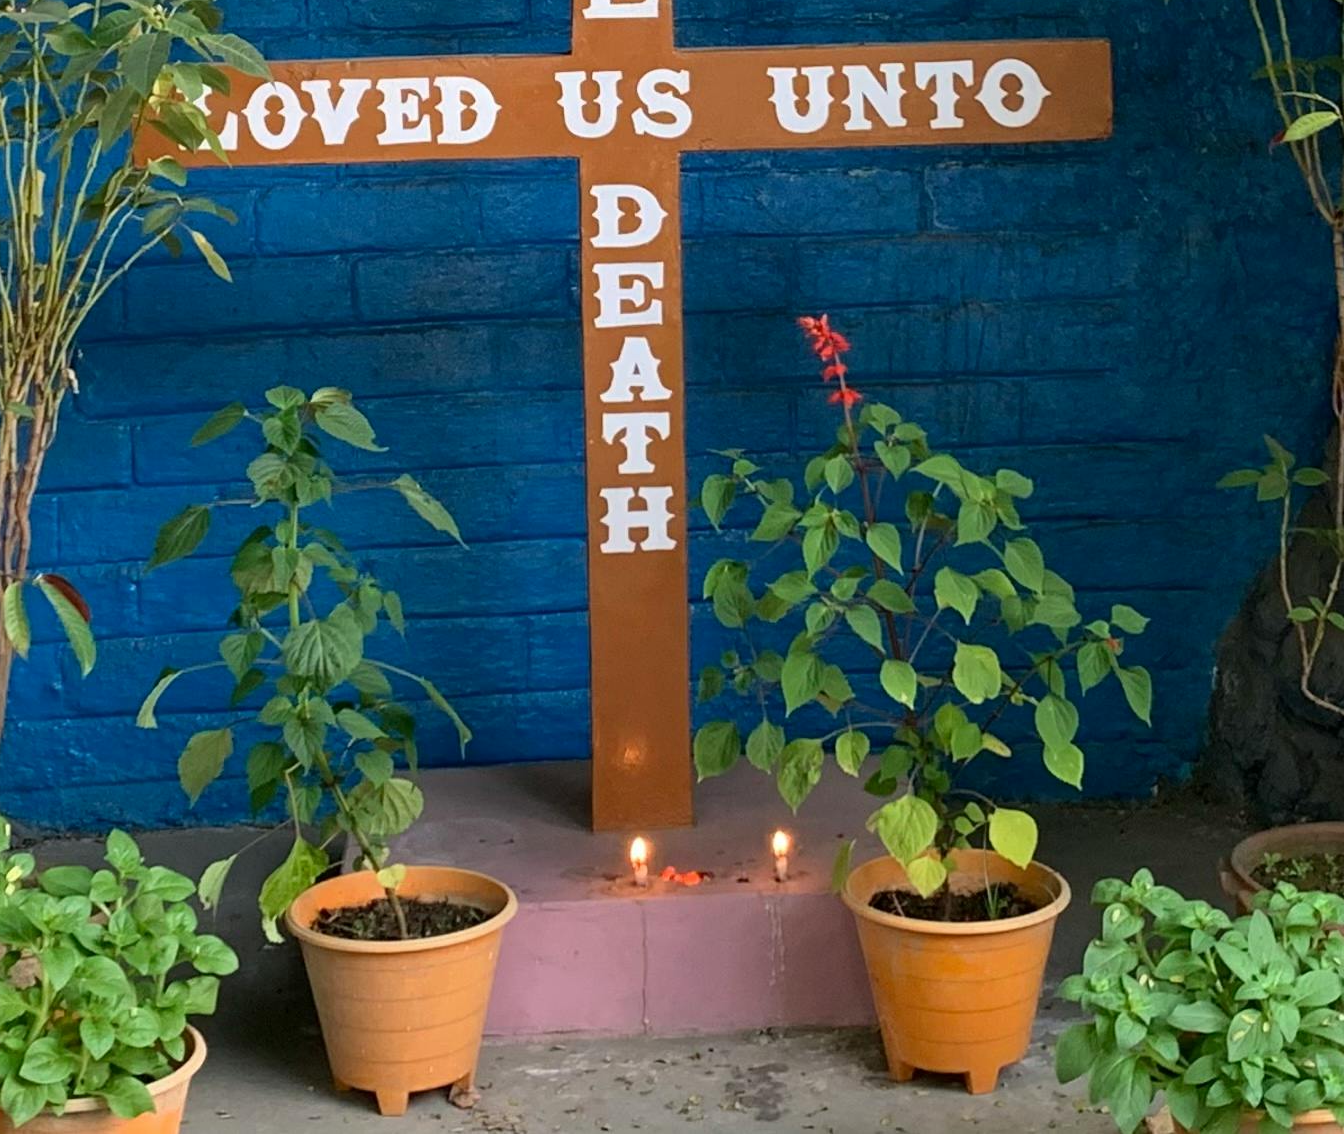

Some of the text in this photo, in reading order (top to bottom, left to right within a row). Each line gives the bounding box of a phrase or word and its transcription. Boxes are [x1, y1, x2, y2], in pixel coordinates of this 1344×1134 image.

[554, 68, 693, 139] US
[766, 58, 1052, 134] UNTO
[589, 183, 678, 554] DEATH
